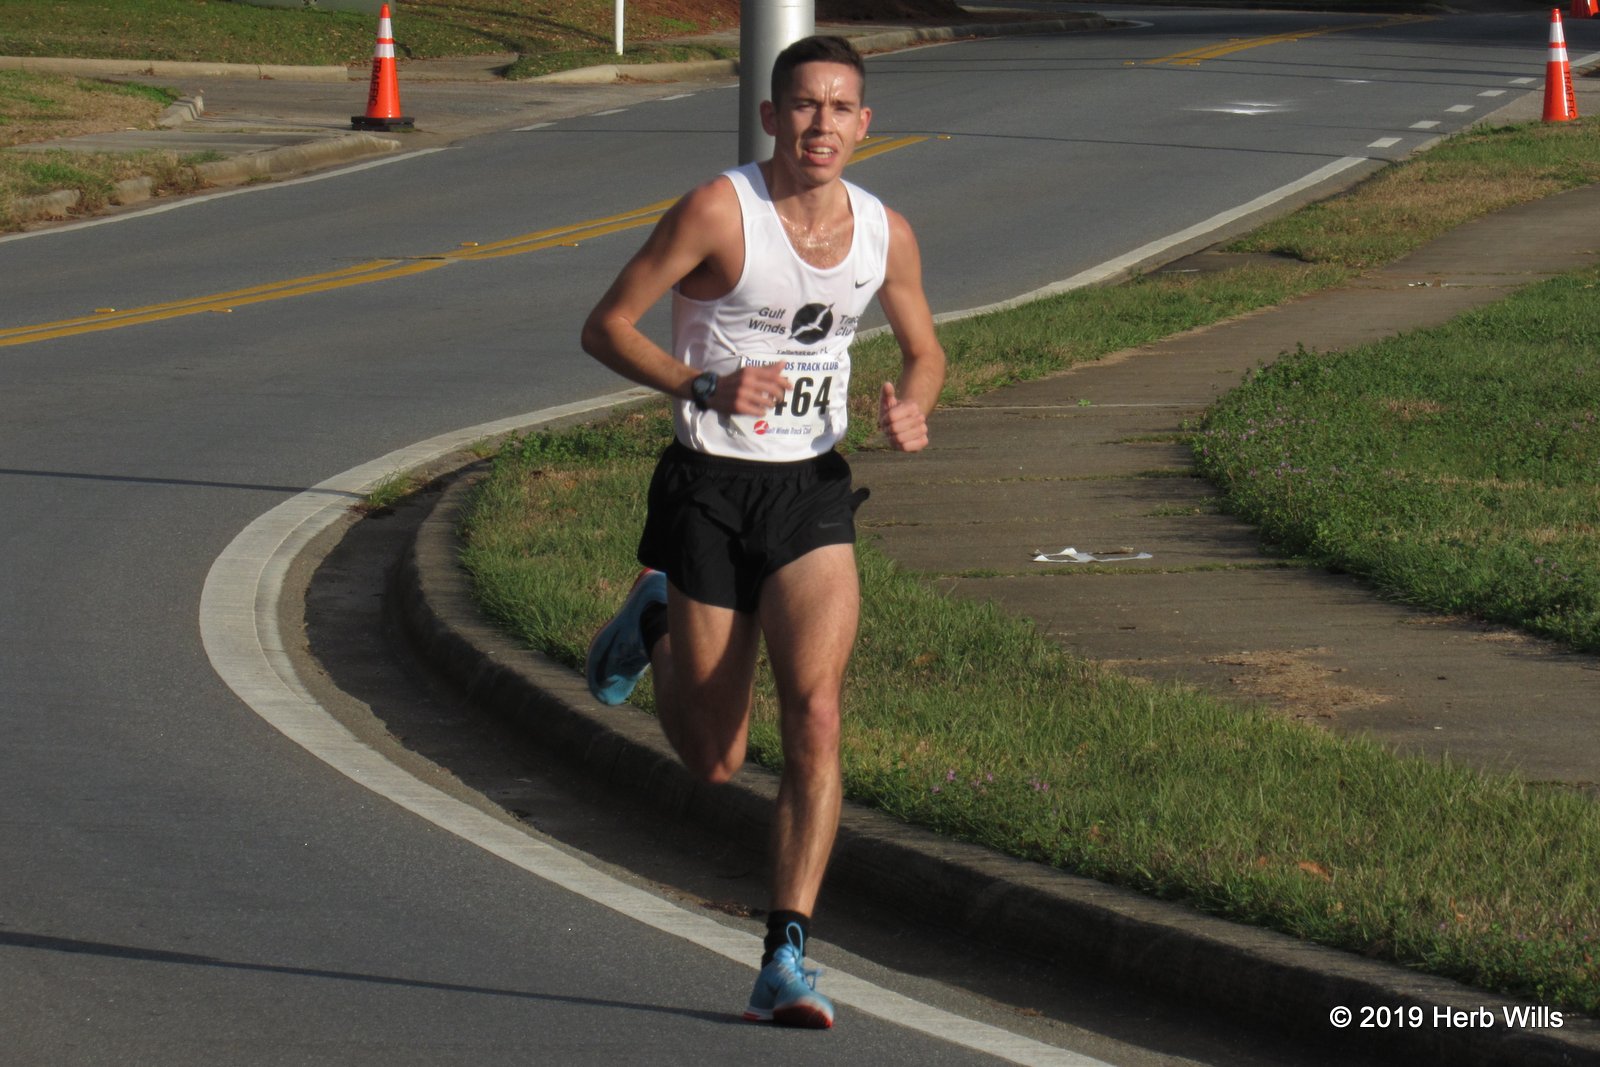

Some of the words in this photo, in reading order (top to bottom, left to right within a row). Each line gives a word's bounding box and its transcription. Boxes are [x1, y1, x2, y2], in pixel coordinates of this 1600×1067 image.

[1563, 71, 1576, 121] TRAFFIC
[759, 307, 786, 319] Gulf
[748, 318, 786, 335] Winds
[797, 362, 821, 371] TRACK
[822, 362, 839, 371] CLUB
